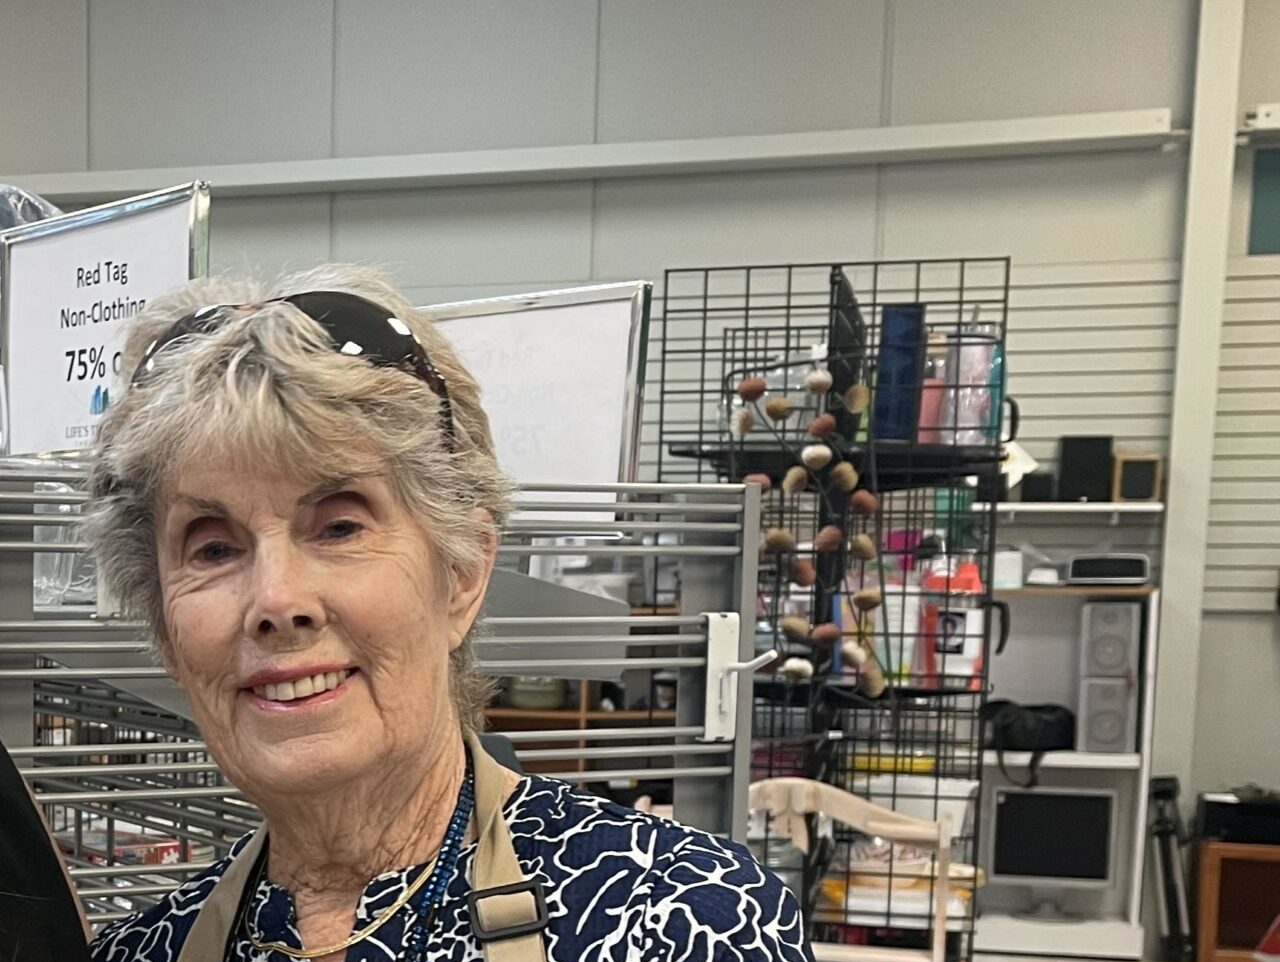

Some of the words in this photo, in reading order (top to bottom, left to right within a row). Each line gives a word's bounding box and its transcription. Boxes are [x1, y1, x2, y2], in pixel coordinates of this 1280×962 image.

[76, 262, 101, 288] Red
[104, 261, 128, 286] Tag
[65, 345, 106, 382] 75%
